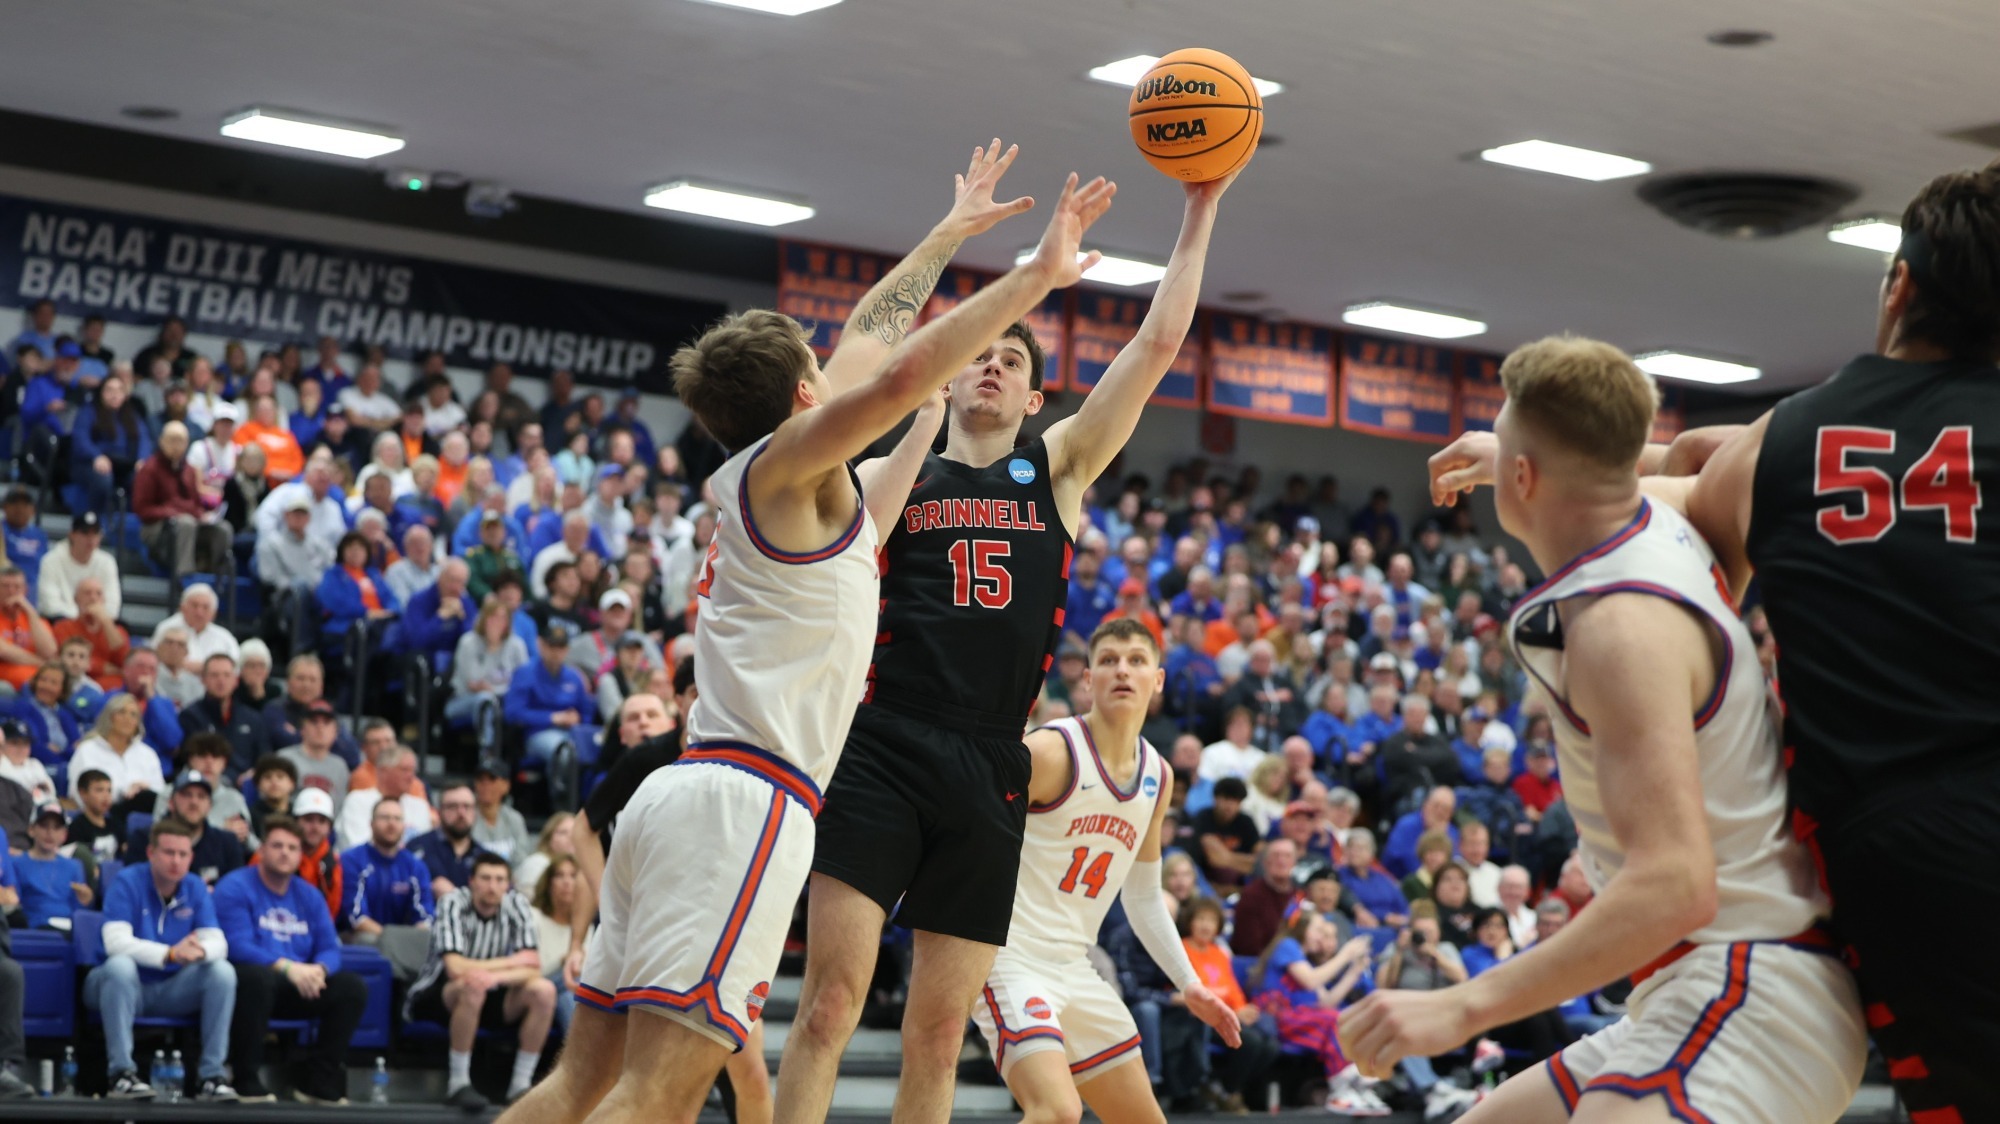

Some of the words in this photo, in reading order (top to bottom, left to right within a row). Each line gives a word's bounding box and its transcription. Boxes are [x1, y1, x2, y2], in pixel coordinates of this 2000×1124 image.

[1137, 74, 1217, 103] Wilson
[1147, 118, 1207, 142] NCAA
[21, 211, 148, 267] NCAA
[165, 232, 267, 285] DIII
[276, 250, 412, 304] MEN'S
[18, 257, 305, 333] BASKETBALL
[317, 299, 655, 379] CHAMPIONSHIP
[1013, 470, 1035, 478] NCAA
[1814, 425, 1982, 545] 54
[904, 498, 1046, 534] GRINNELL
[948, 539, 1012, 609] 15
[1058, 846, 1114, 899] 14
